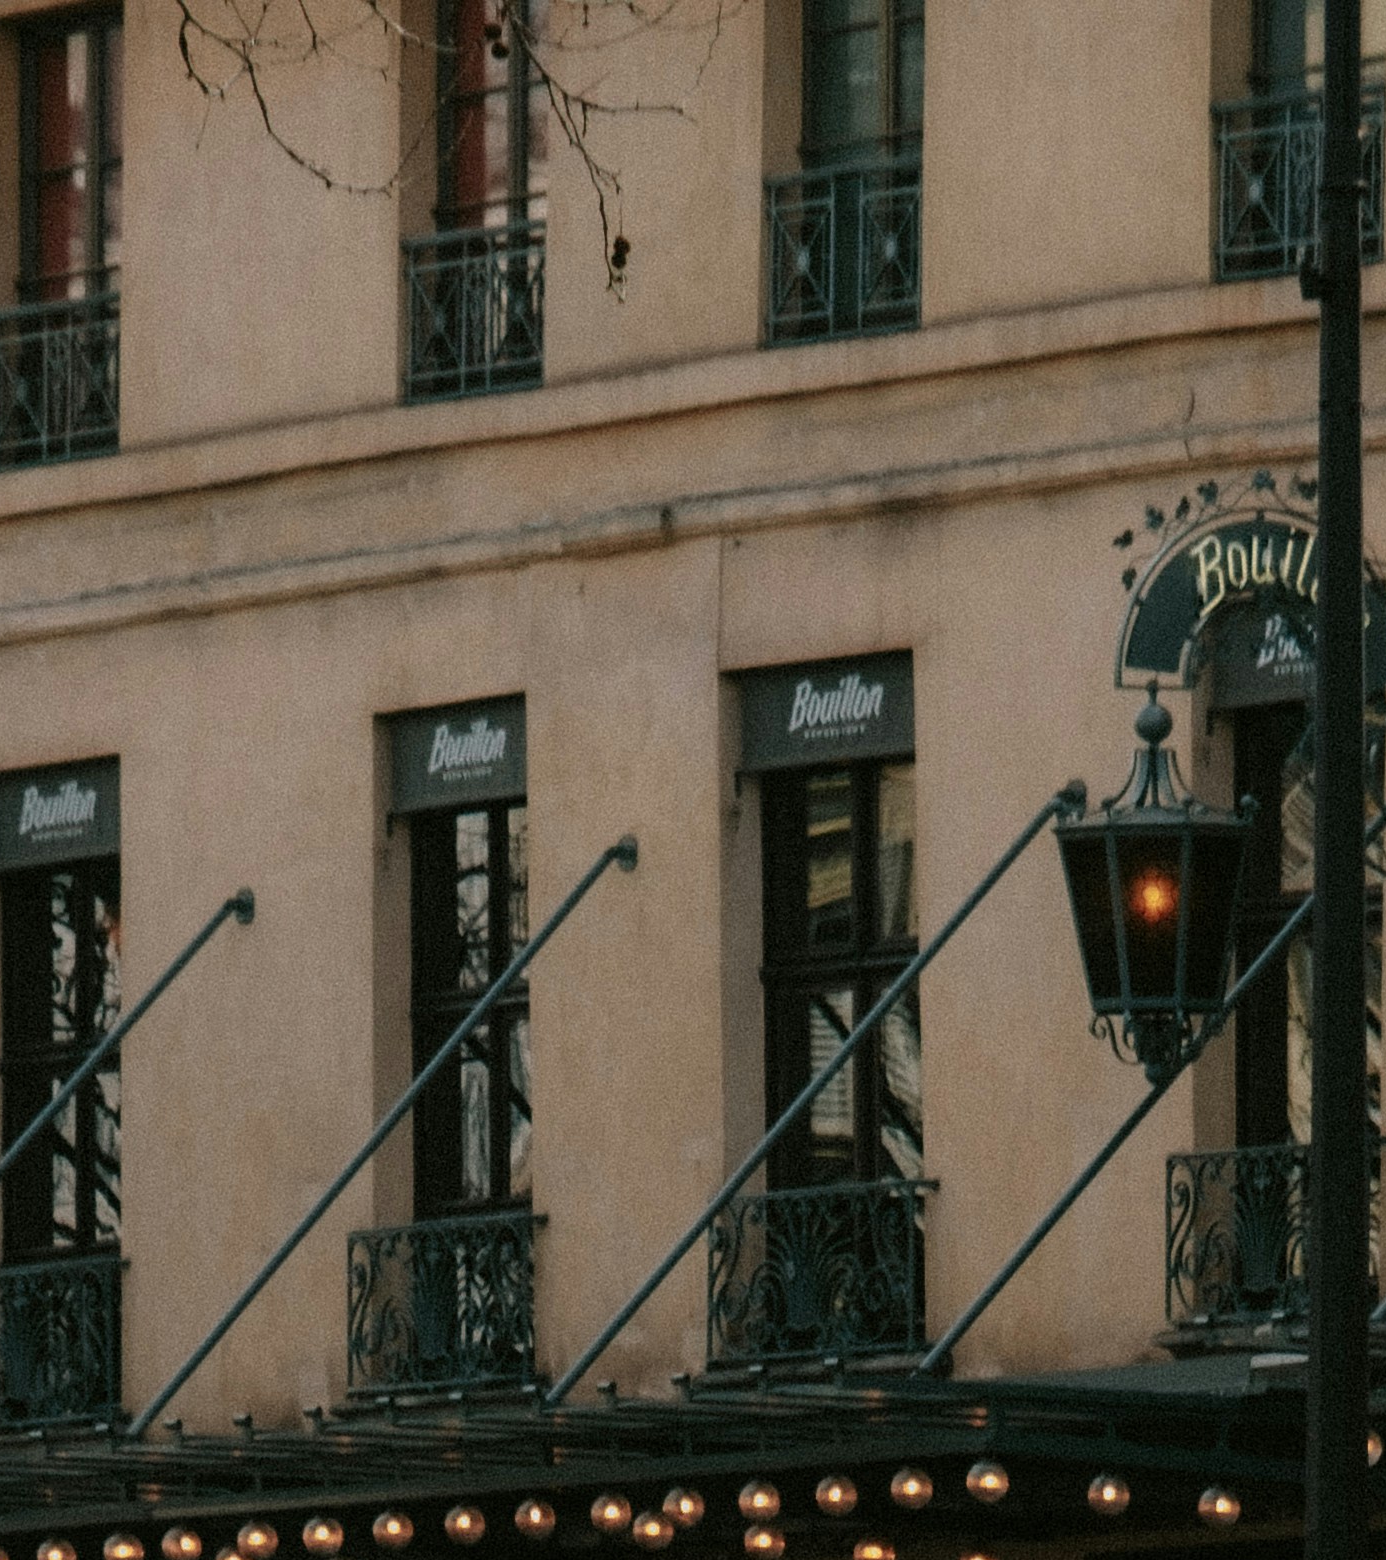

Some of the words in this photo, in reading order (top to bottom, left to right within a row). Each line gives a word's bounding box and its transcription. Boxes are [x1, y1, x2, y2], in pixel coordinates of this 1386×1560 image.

[1188, 527, 1319, 618] Bouil
[788, 673, 884, 733] Bouillon
[427, 717, 507, 774] Bouillon
[18, 780, 97, 835] Bouillon
